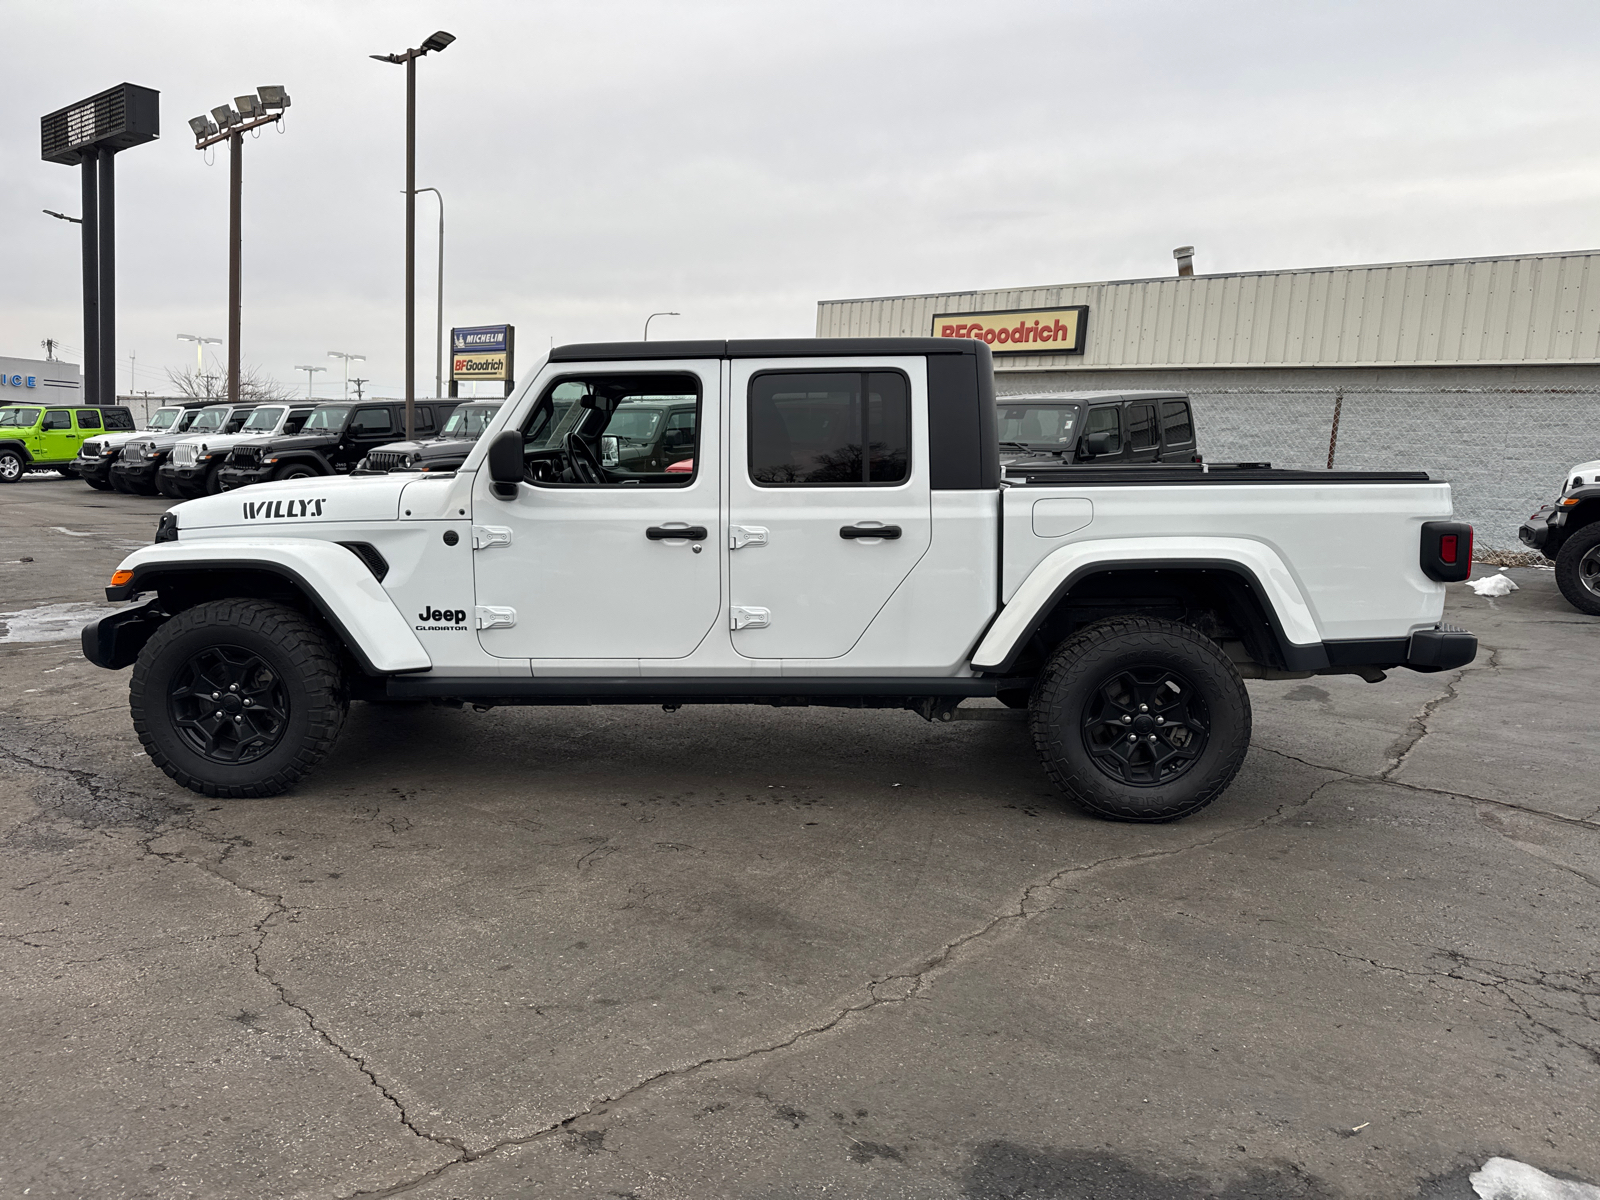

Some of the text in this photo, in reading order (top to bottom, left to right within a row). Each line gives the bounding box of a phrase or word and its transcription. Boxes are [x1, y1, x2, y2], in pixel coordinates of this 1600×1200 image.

[466, 333, 504, 343] MICHELIN
[941, 319, 1068, 344] BFGoodrich
[455, 359, 504, 371] BFGoodrich
[2, 374, 37, 388] ICE
[243, 498, 327, 519] WILLYS
[418, 605, 466, 624] Jeep
